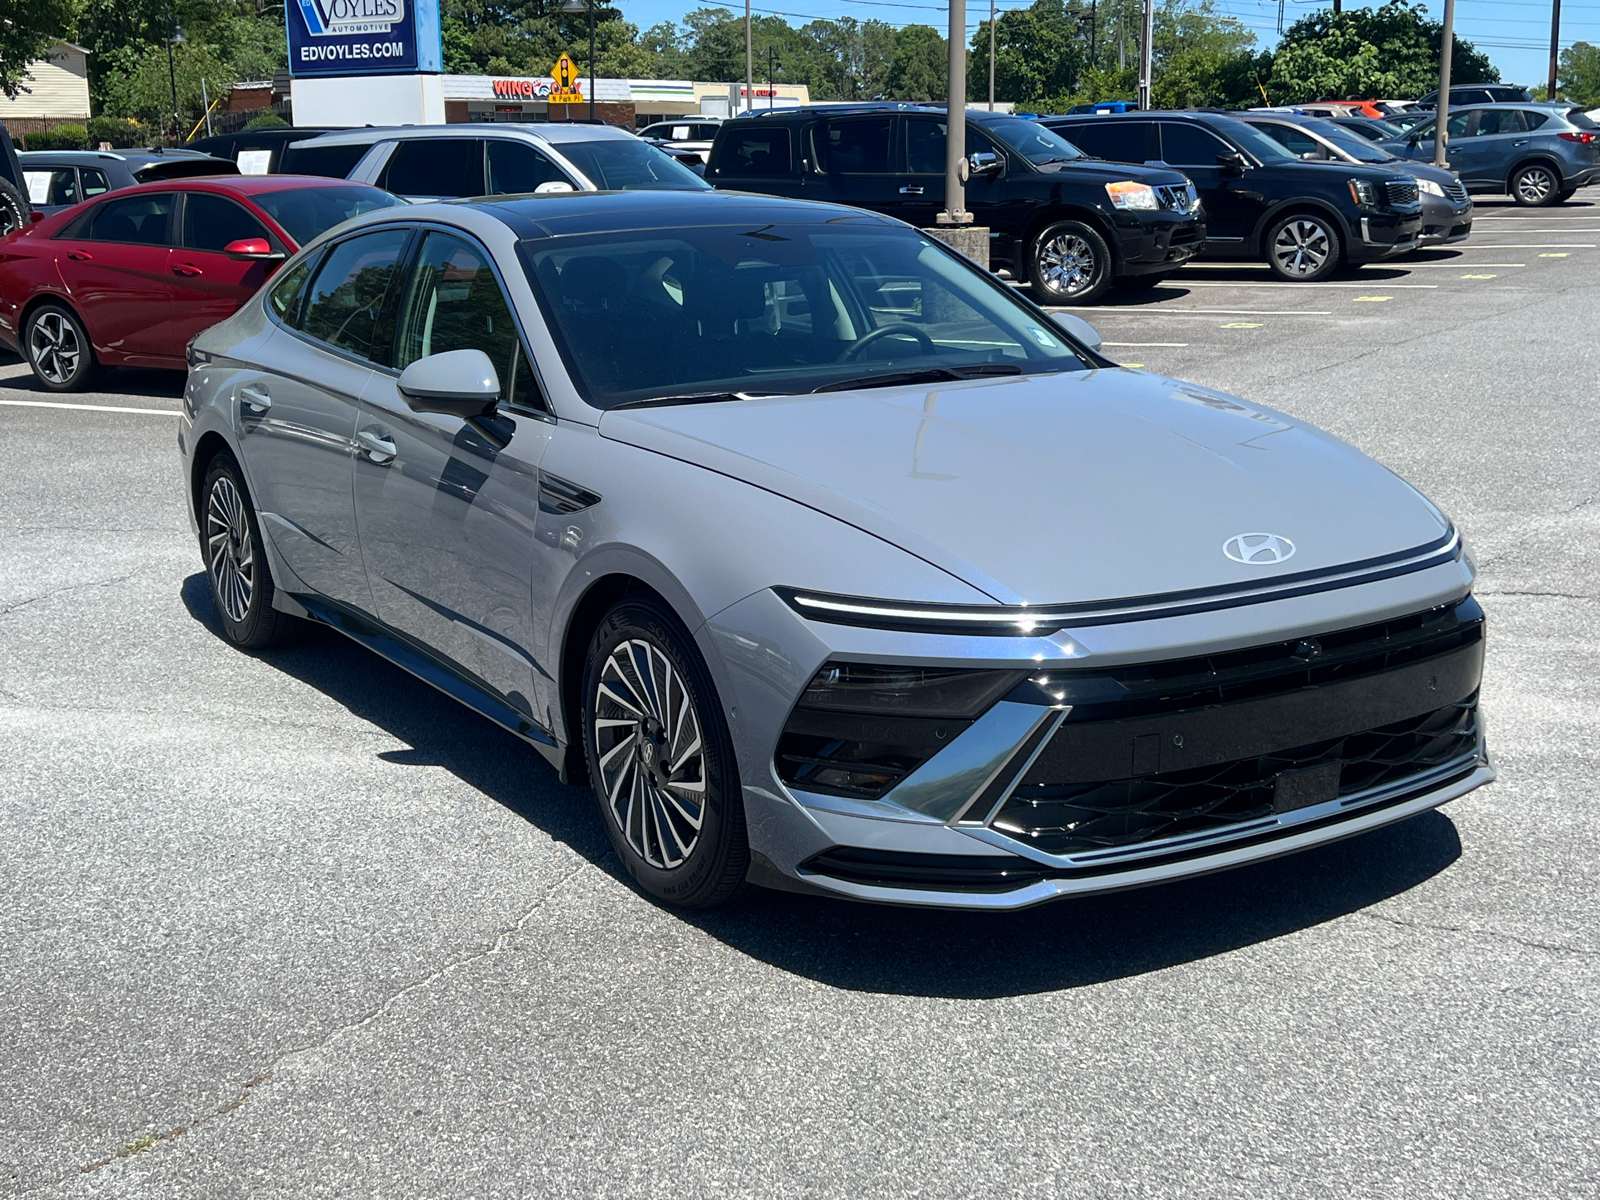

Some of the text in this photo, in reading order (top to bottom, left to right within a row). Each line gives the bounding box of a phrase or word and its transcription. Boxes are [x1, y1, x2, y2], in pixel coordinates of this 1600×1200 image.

[311, 0, 397, 29] VOYLES
[331, 24, 390, 33] AUTOMOTIVE
[300, 42, 403, 61] EDVOYLES.COM
[493, 80, 582, 95] WING CY
[647, 621, 688, 675] SOLUS
[581, 707, 595, 790] KUMHO
[678, 879, 689, 893] R17
